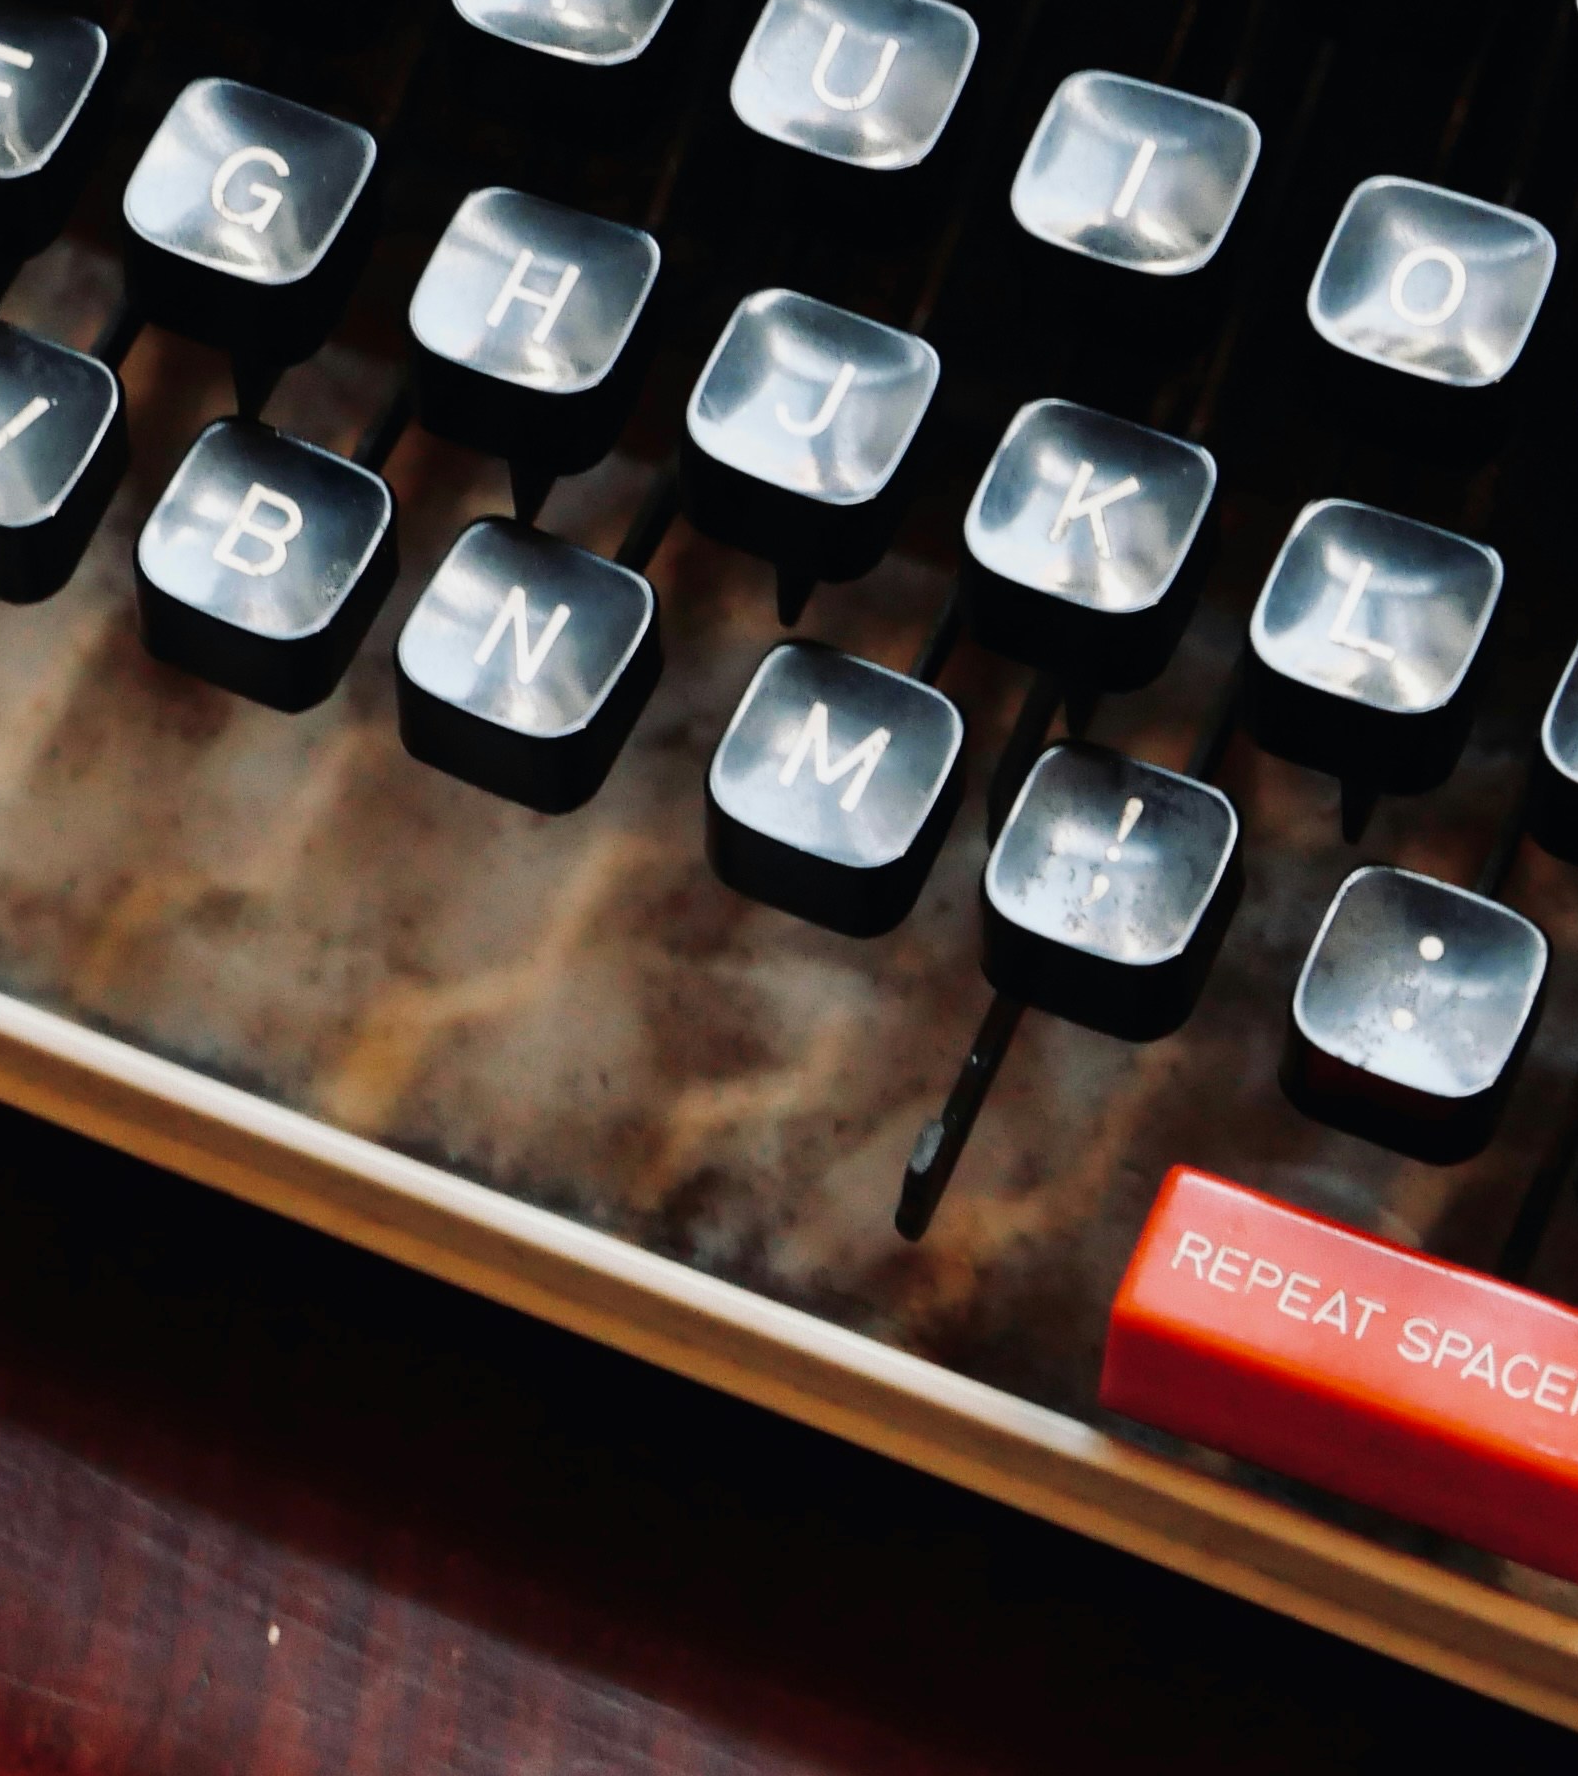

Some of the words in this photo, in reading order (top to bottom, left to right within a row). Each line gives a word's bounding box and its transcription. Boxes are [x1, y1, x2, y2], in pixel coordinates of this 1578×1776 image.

[812, 22, 901, 111] U
[211, 146, 290, 234] G
[1113, 139, 1157, 218] I
[485, 248, 581, 344] H
[1389, 246, 1466, 326] O
[775, 363, 856, 436] J
[213, 482, 303, 577] B
[1049, 460, 1140, 560] K
[473, 585, 571, 684] N
[1329, 561, 1395, 661] L
[778, 701, 891, 813] M
[1105, 797, 1143, 863] !
[1170, 1229, 1387, 1341] REPEAT
